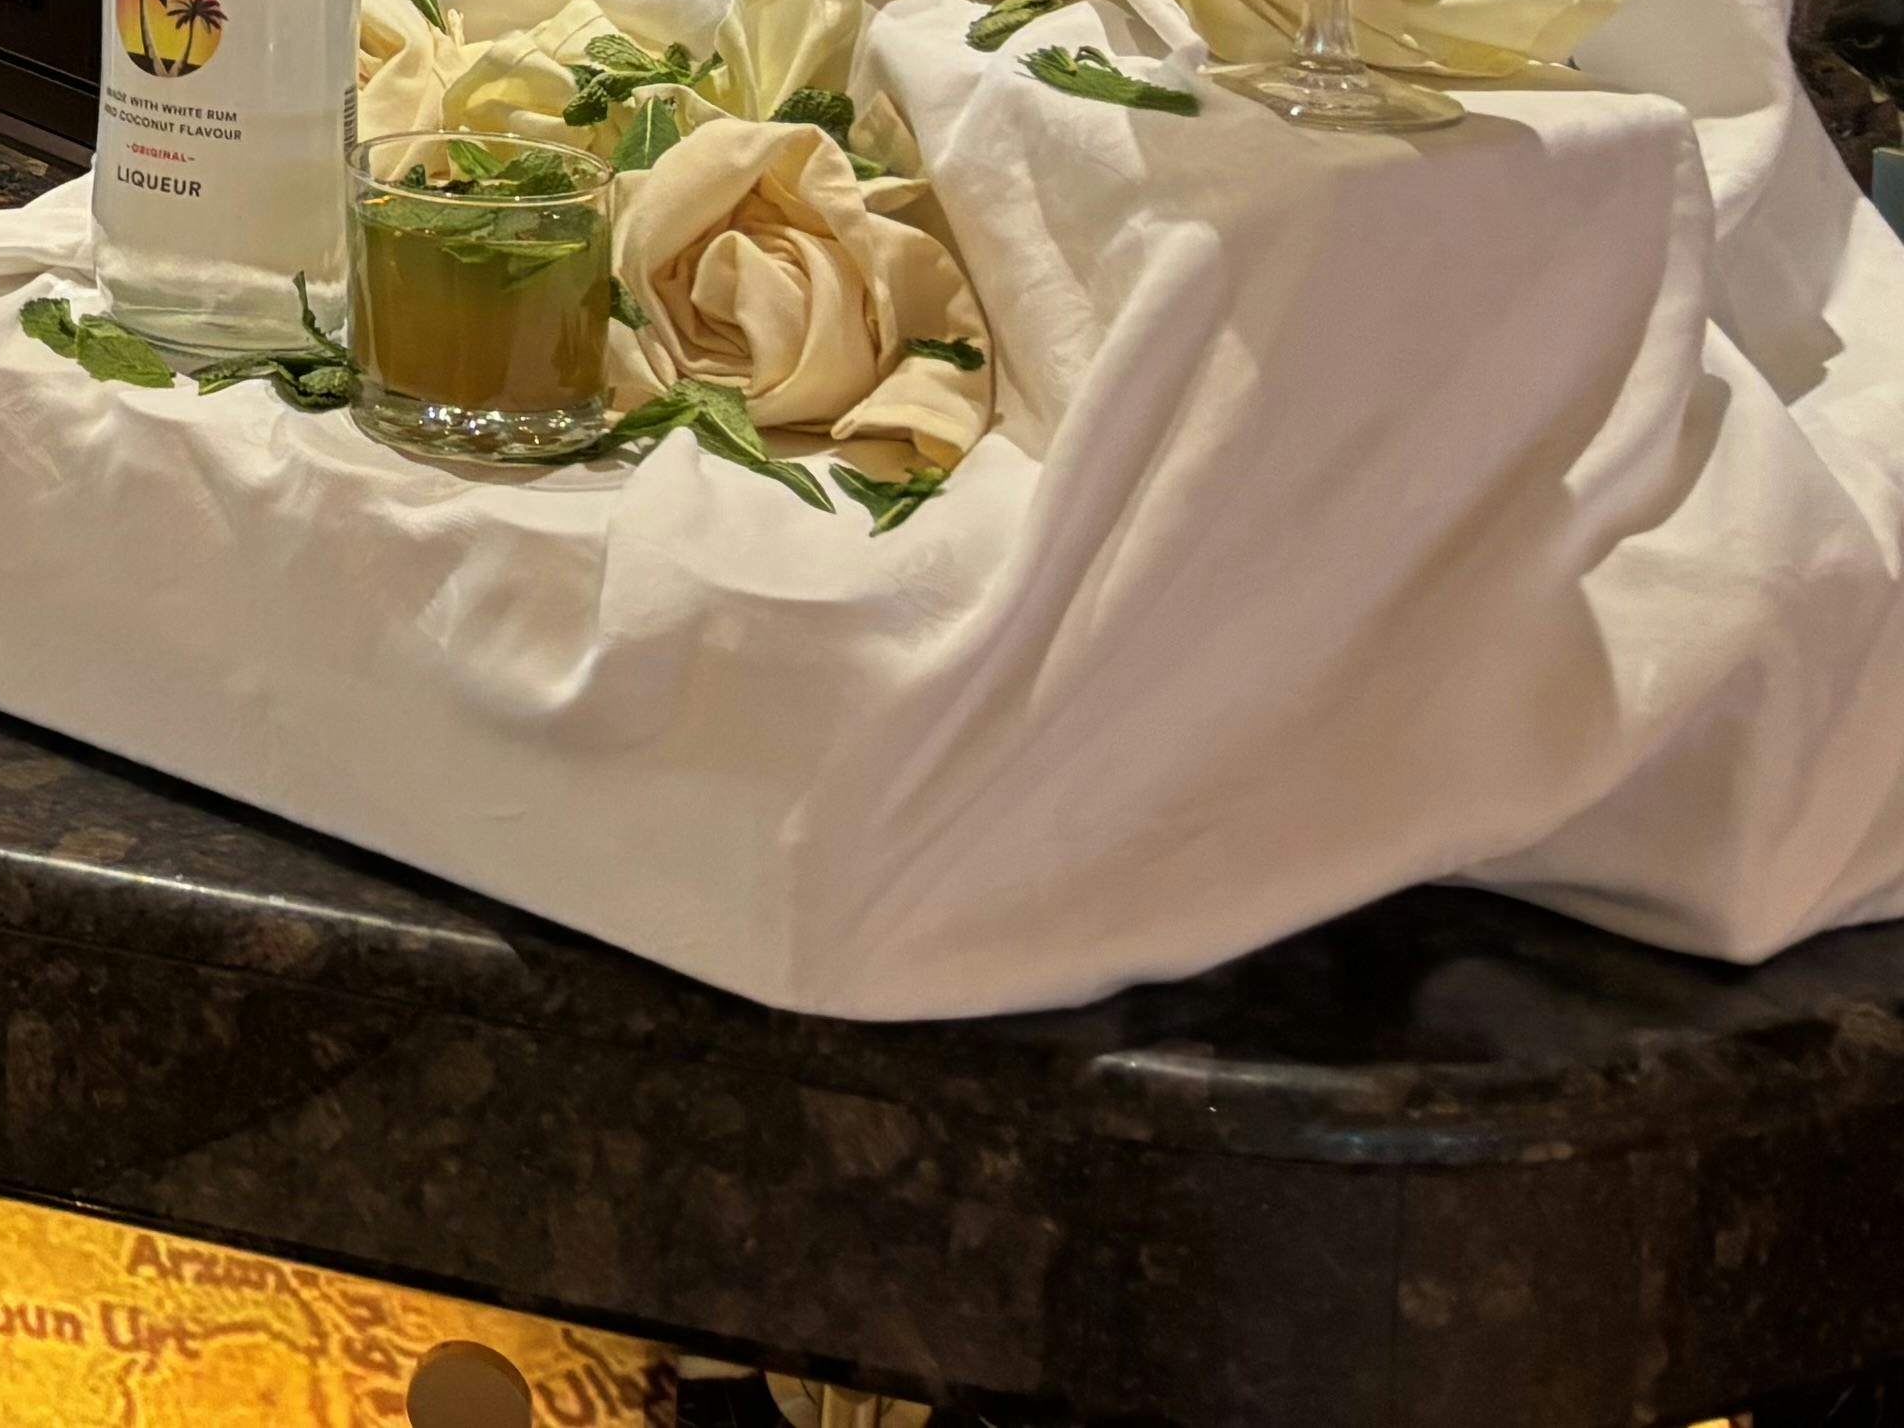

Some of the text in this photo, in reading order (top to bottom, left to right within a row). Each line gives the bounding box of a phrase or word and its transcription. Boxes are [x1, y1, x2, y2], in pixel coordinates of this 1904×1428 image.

[130, 96, 159, 112] WITH
[161, 103, 203, 120] WHITE
[206, 109, 237, 122] RUM
[119, 110, 175, 133] COCONUT
[179, 123, 242, 141] FLAVOUR
[117, 164, 202, 198] LIQUEUR
